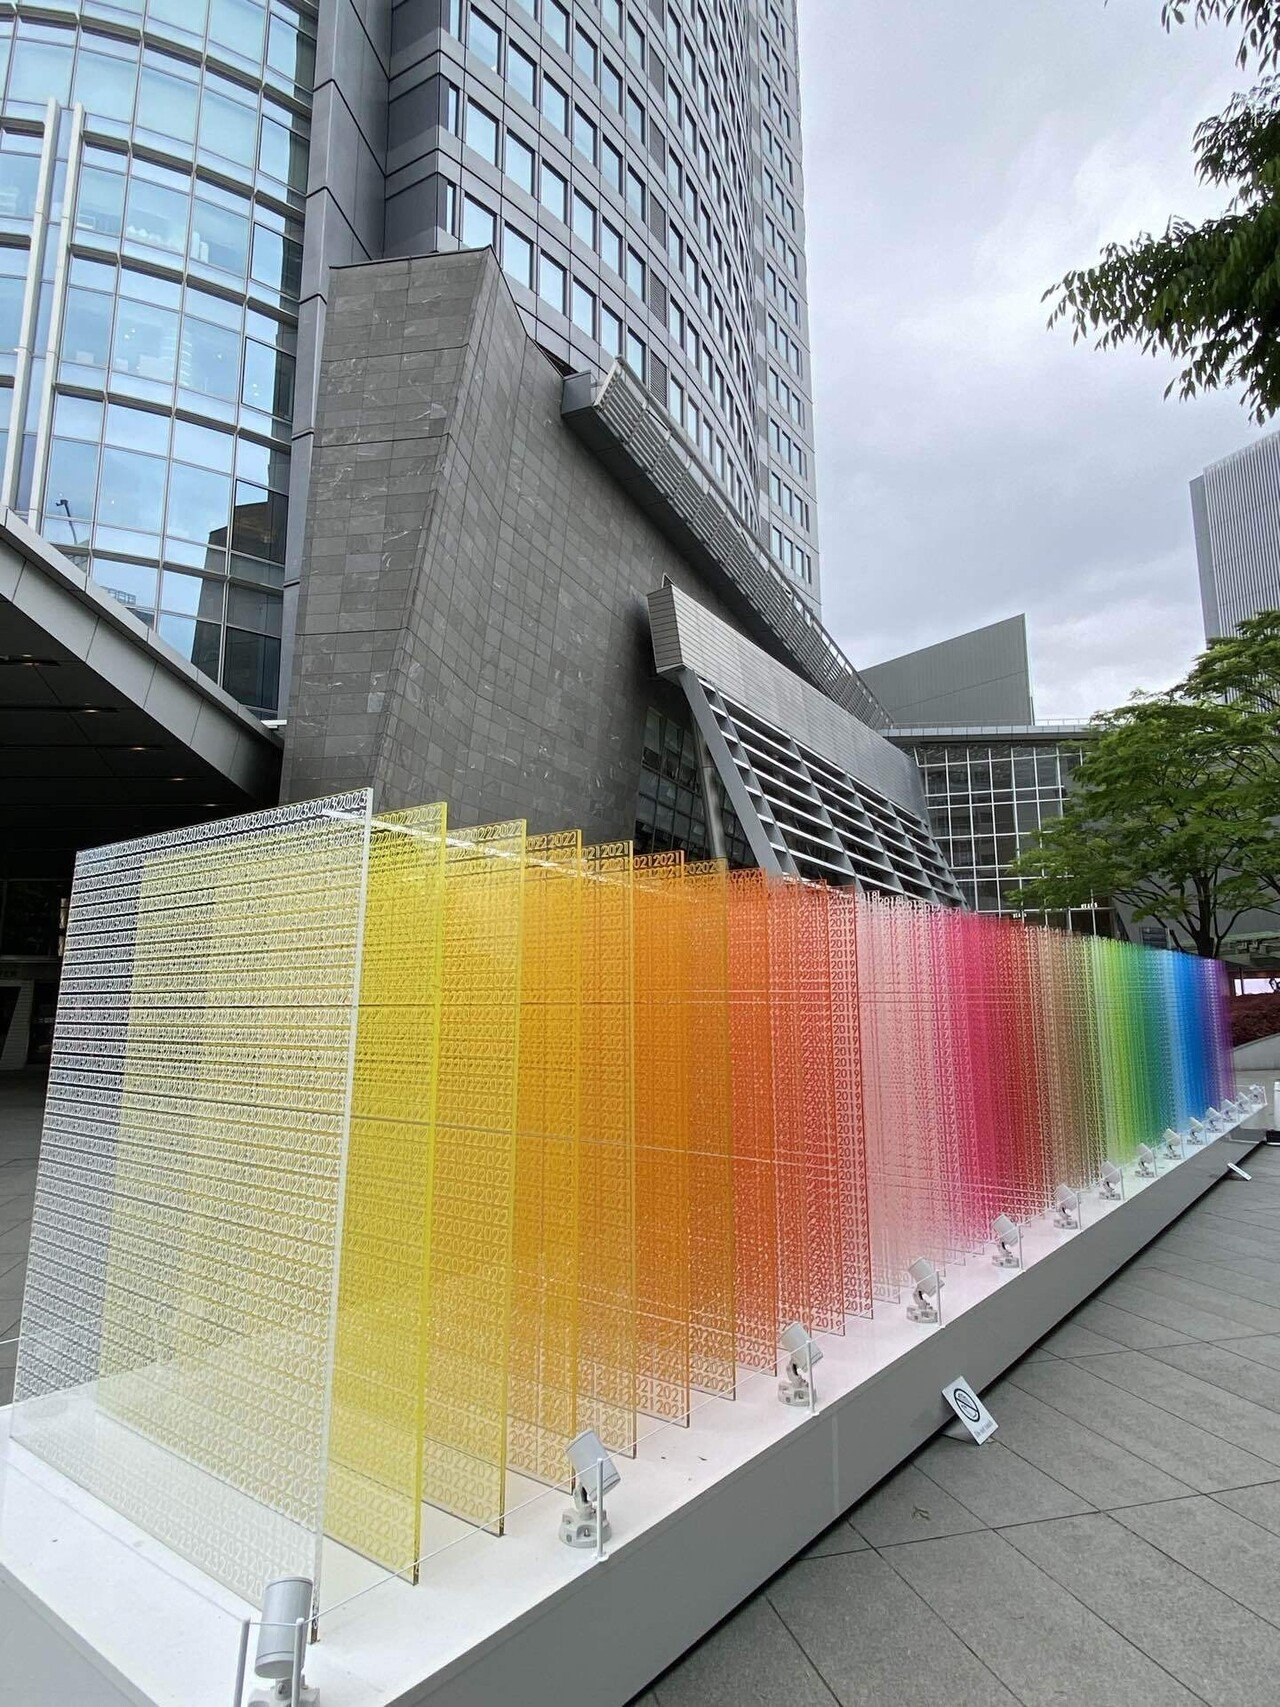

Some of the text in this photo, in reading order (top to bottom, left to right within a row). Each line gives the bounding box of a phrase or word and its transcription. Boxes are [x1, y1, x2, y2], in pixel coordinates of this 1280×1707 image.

[602, 842, 629, 858] 2021
[653, 853, 679, 867] 2021
[656, 1383, 685, 1404] 2021
[656, 1399, 685, 1419] 2021
